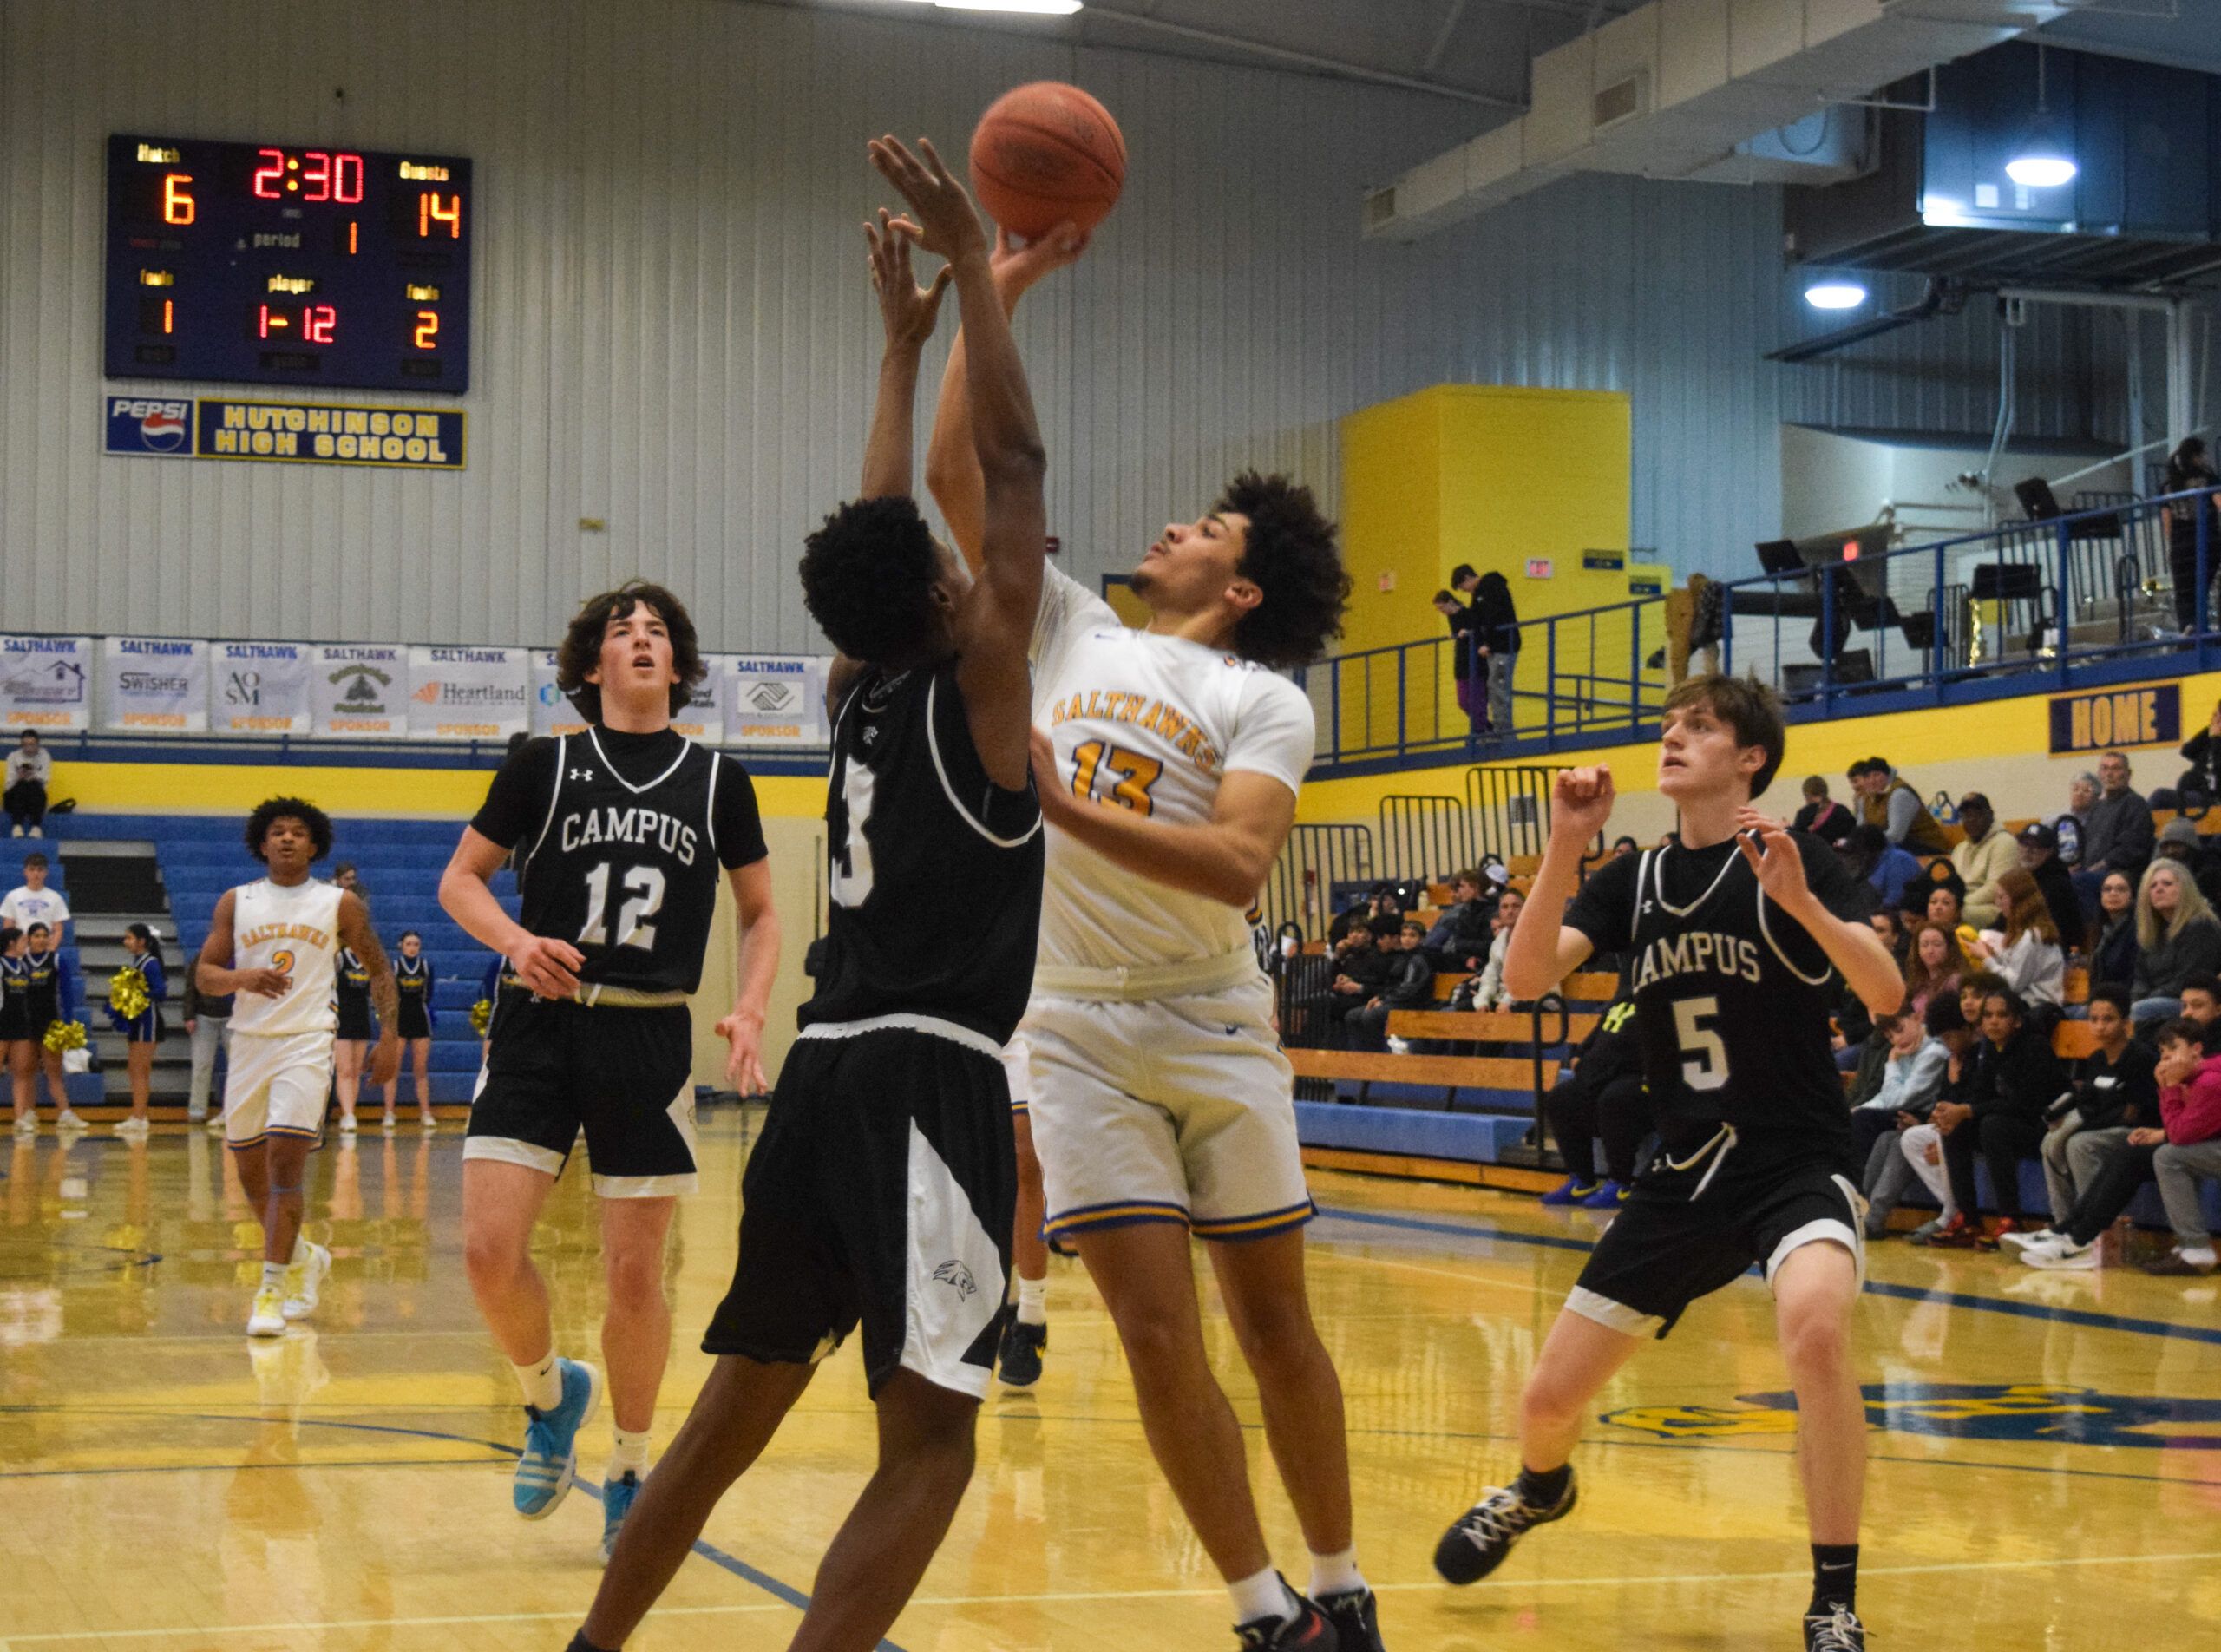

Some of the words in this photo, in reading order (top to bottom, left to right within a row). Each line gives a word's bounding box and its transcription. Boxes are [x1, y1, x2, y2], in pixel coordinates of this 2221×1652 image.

[254, 149, 364, 203] 2:30
[400, 161, 449, 182] Guests
[165, 174, 195, 225] 6
[420, 193, 461, 239] 14
[253, 232, 301, 249] period
[349, 220, 357, 255] 1
[268, 273, 315, 295] player
[164, 299, 174, 334] 1
[416, 311, 439, 349] 2
[112, 400, 187, 418] PEPSI
[224, 405, 439, 438] HUTCHINSON
[215, 429, 298, 456] HIGH
[314, 435, 446, 462] SCHOOL
[4, 639, 76, 653] SALTHAWK
[121, 640, 193, 656] SALTHAWK
[226, 646, 298, 659] SALTHAWK
[324, 648, 396, 660] SALTHAWK
[431, 650, 506, 663] SALTHAWK
[737, 661, 804, 673] SALTHAWK
[443, 683, 525, 701] Heartland
[2071, 691, 2159, 749] HOME
[1071, 738, 1163, 817] 13
[562, 807, 698, 866] CAMPUS
[577, 862, 666, 952] 12
[240, 922, 330, 951] SALTHAWKS
[272, 950, 295, 990] 2
[1673, 996, 1731, 1092] 5
